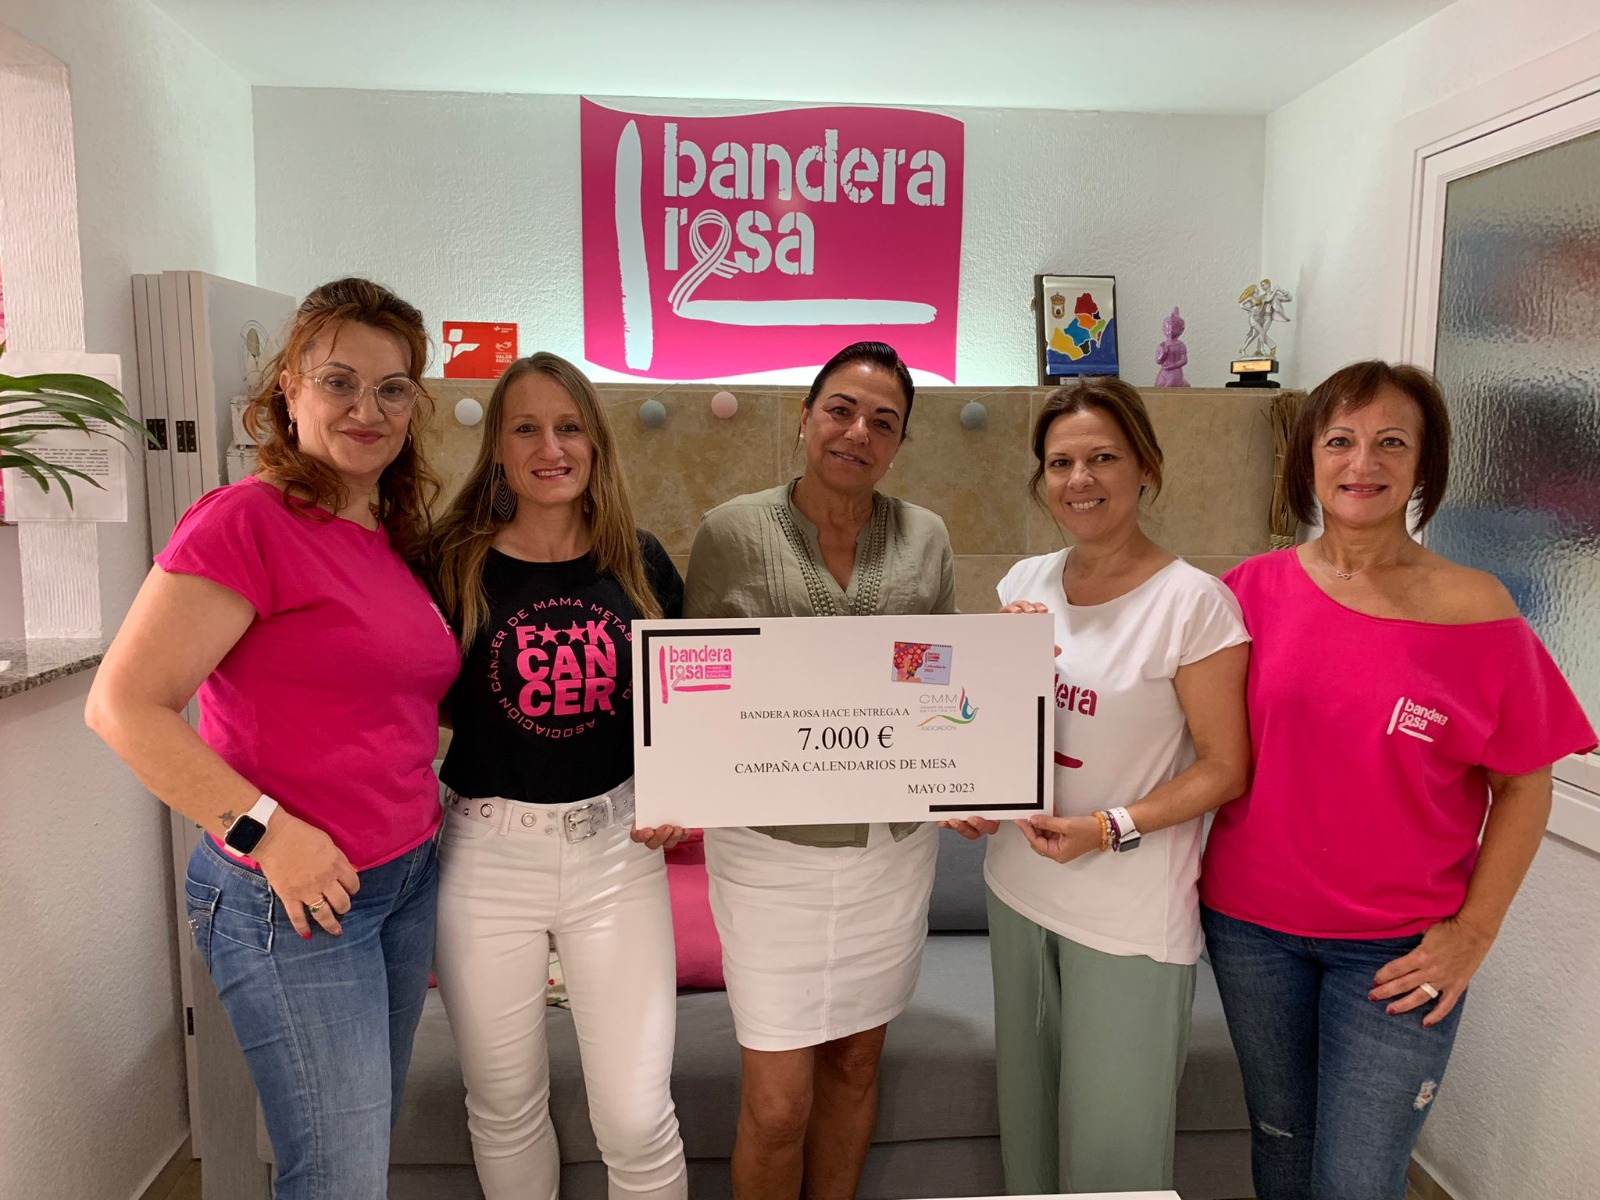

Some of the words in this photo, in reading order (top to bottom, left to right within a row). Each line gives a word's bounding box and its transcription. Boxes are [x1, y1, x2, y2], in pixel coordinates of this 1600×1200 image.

[663, 122, 946, 207] bandera
[663, 206, 815, 278] rosa
[507, 608, 529, 627] DE
[533, 597, 584, 611] MAMA
[516, 643, 617, 682] CAN
[669, 645, 732, 663] bandera
[669, 664, 704, 681] rosa
[919, 694, 958, 704] CMM
[740, 710, 790, 720] BANDERA
[792, 709, 820, 718] ROSA
[822, 708, 850, 718] HACE
[853, 708, 900, 717] ENTREGA
[901, 707, 910, 716] A
[1399, 711, 1428, 731] rosa
[1403, 698, 1449, 726] bandera
[797, 726, 869, 750] 7.000
[877, 725, 894, 749] €
[734, 760, 800, 774] CAMPAÑA
[802, 760, 896, 772] CALENDARIOS
[900, 759, 917, 770] DE
[920, 758, 957, 769] MESA
[908, 783, 946, 794] MAYO
[949, 782, 975, 793] 2023
